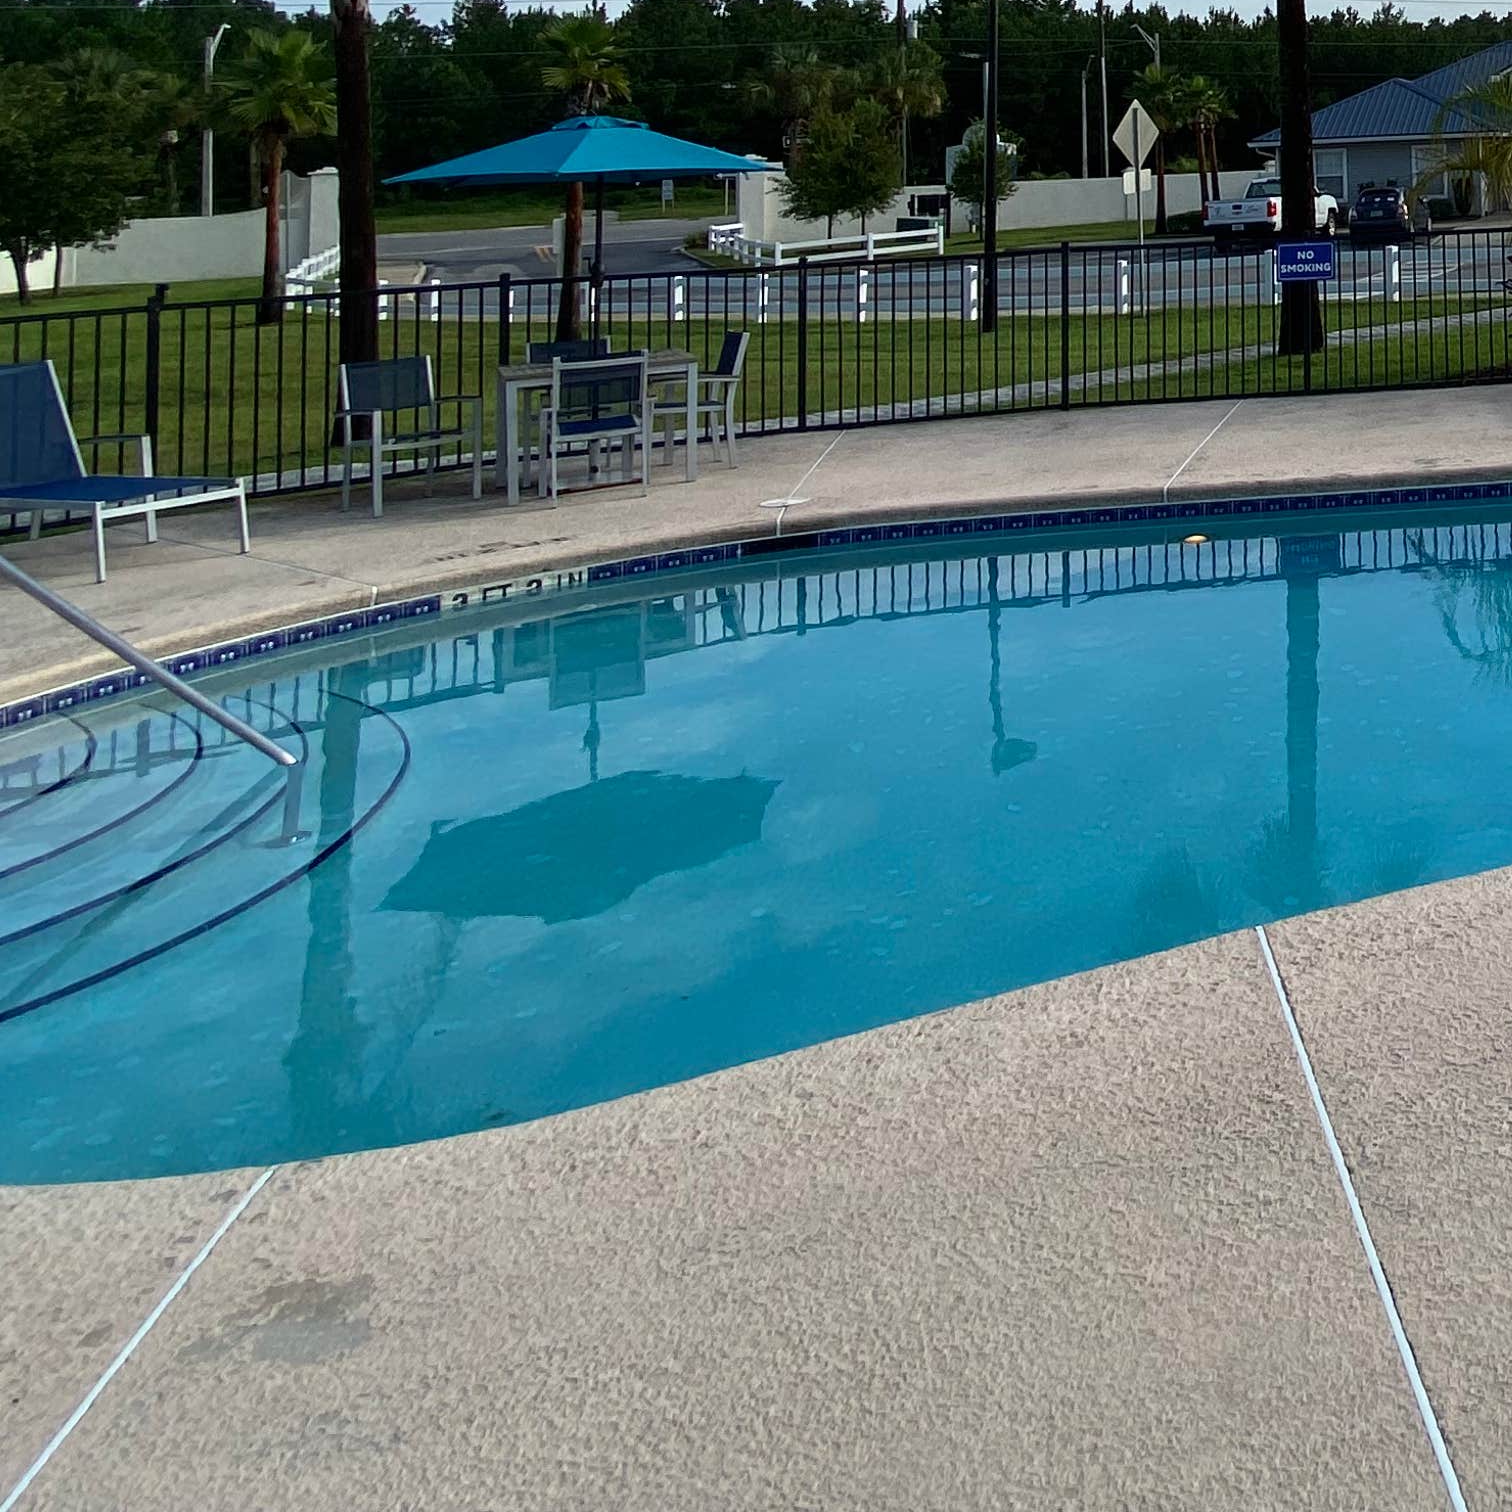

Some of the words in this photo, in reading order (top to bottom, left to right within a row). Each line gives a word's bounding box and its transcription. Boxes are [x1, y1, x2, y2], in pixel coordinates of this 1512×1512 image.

[1297, 250, 1314, 260] NO
[1280, 262, 1331, 273] SMOKING
[557, 570, 583, 586] IN
